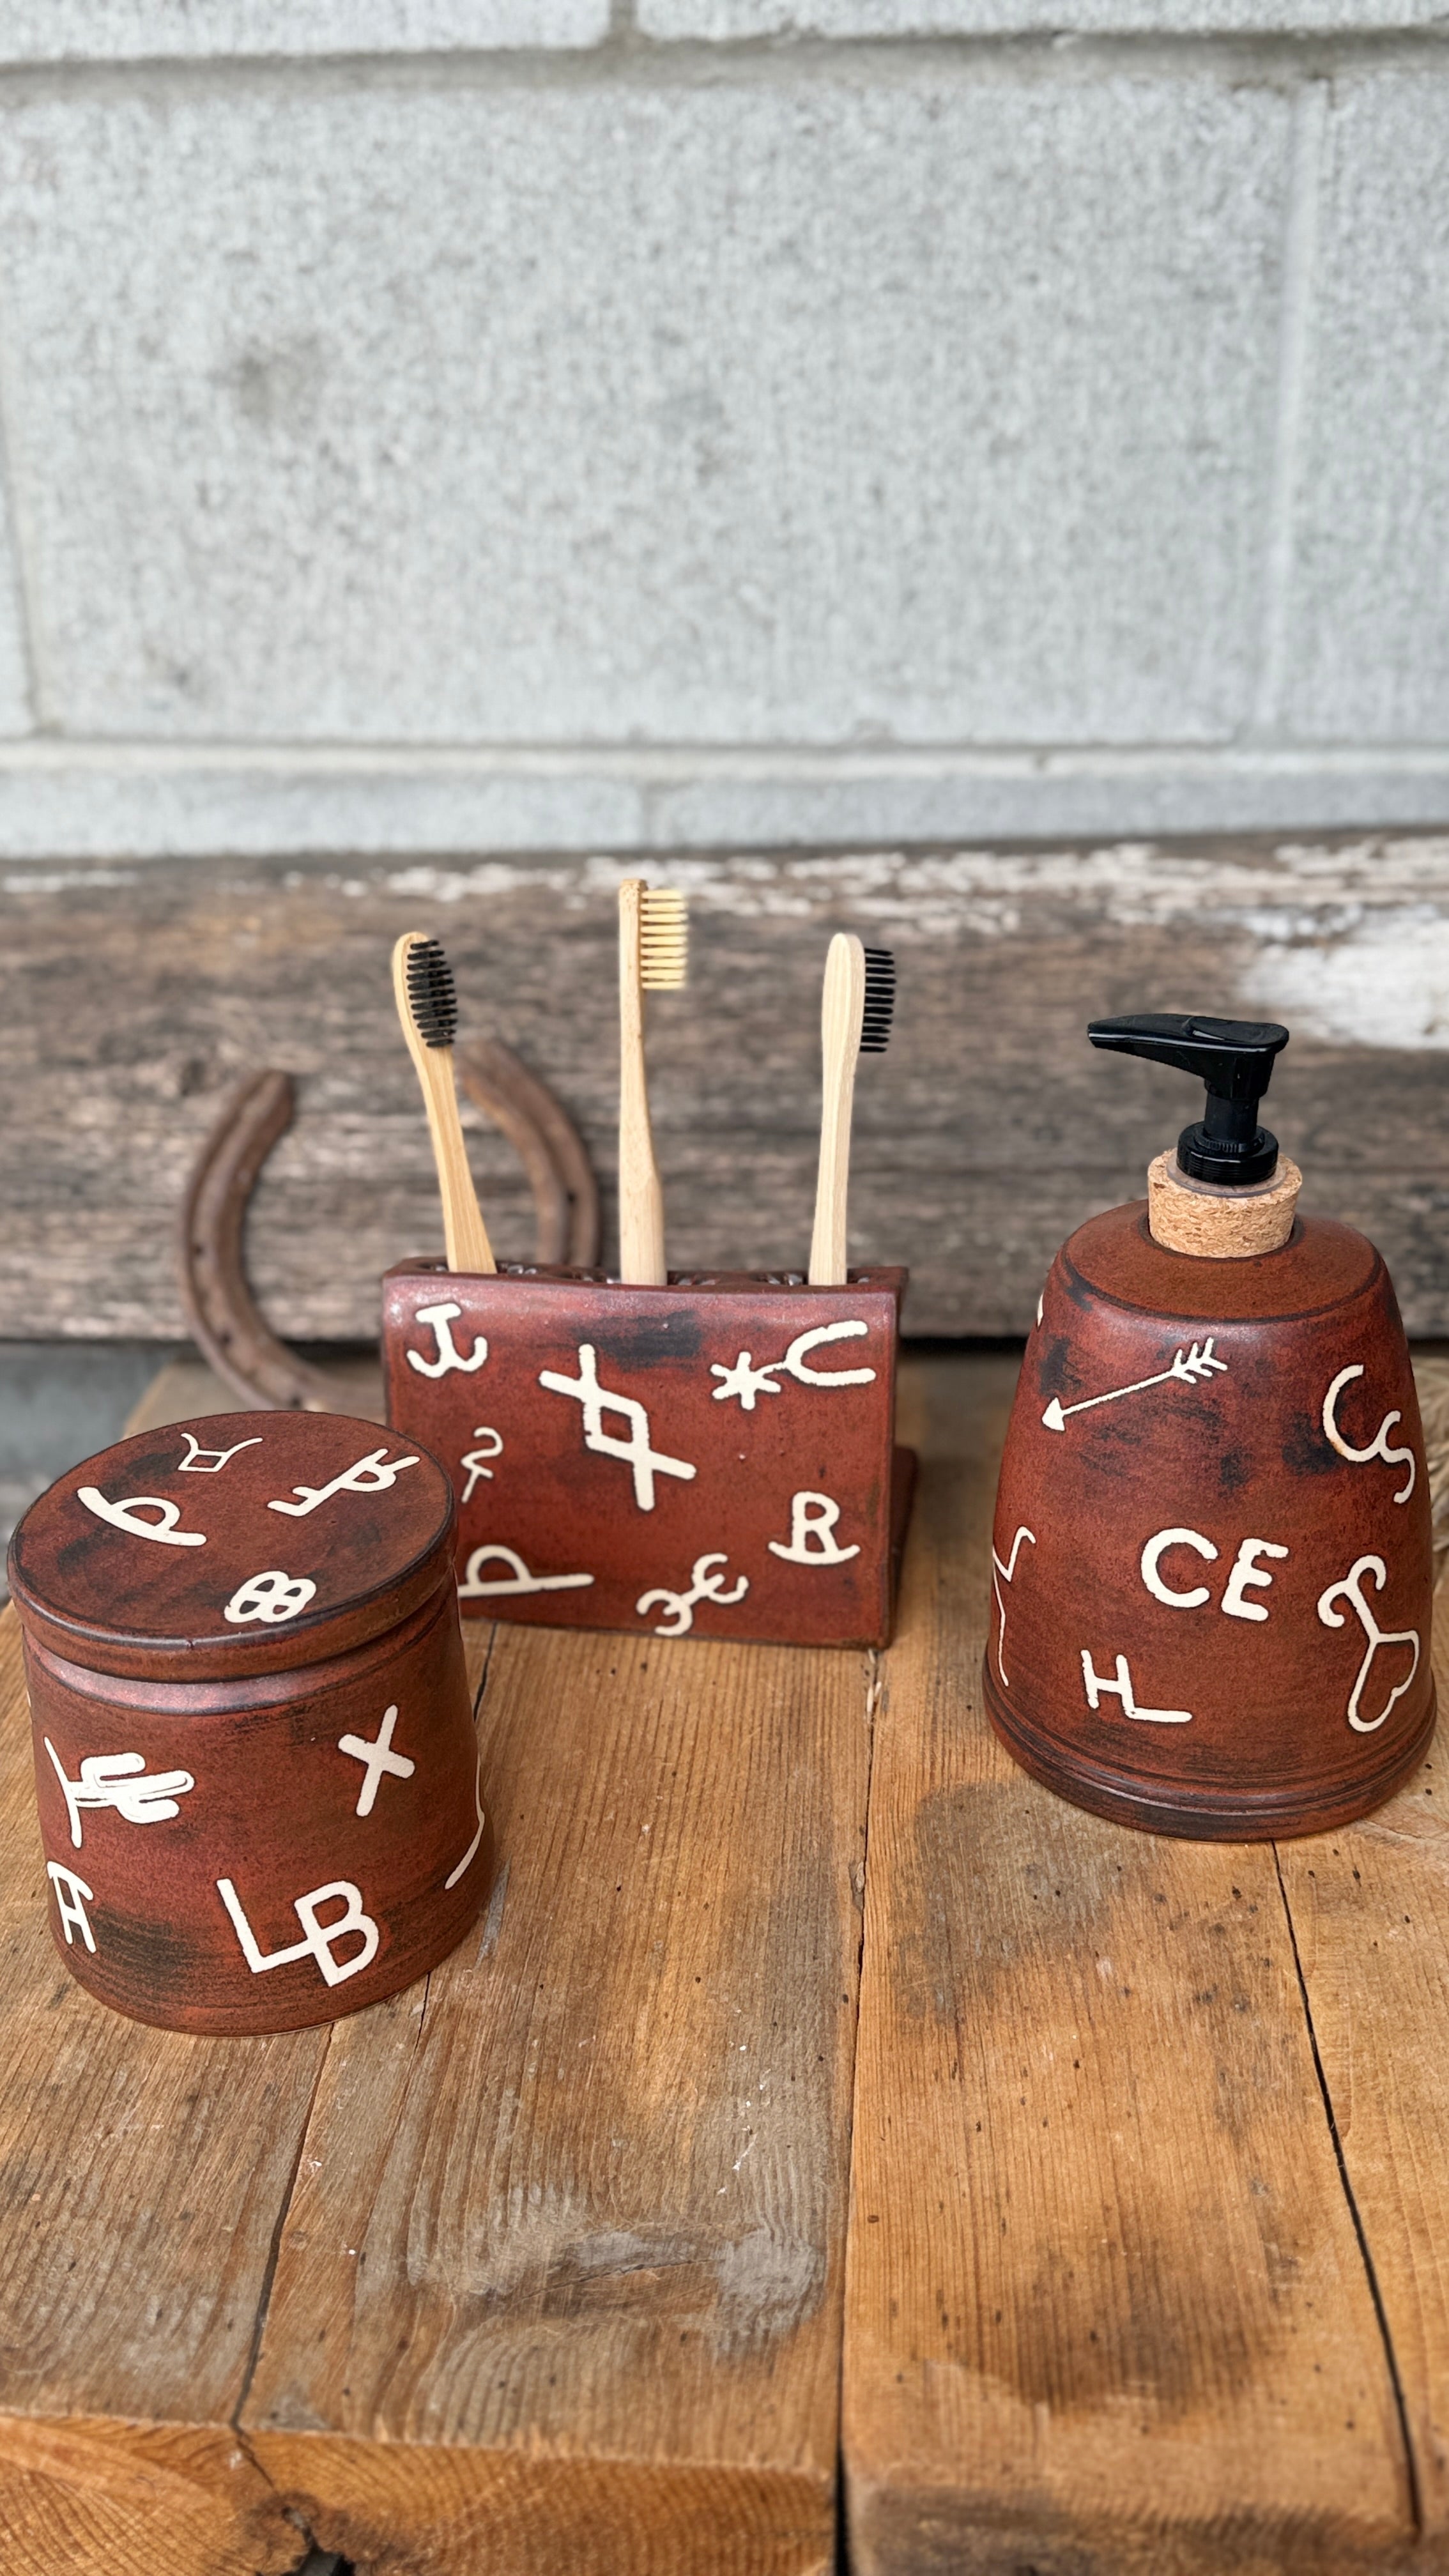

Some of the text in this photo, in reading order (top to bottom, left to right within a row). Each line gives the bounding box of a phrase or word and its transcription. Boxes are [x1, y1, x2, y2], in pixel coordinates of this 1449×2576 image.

[769, 1491, 861, 1565] R
[1140, 1528, 1289, 1621] CE
[1080, 1650, 1193, 1723] HL
[216, 1878, 380, 1988] LB
